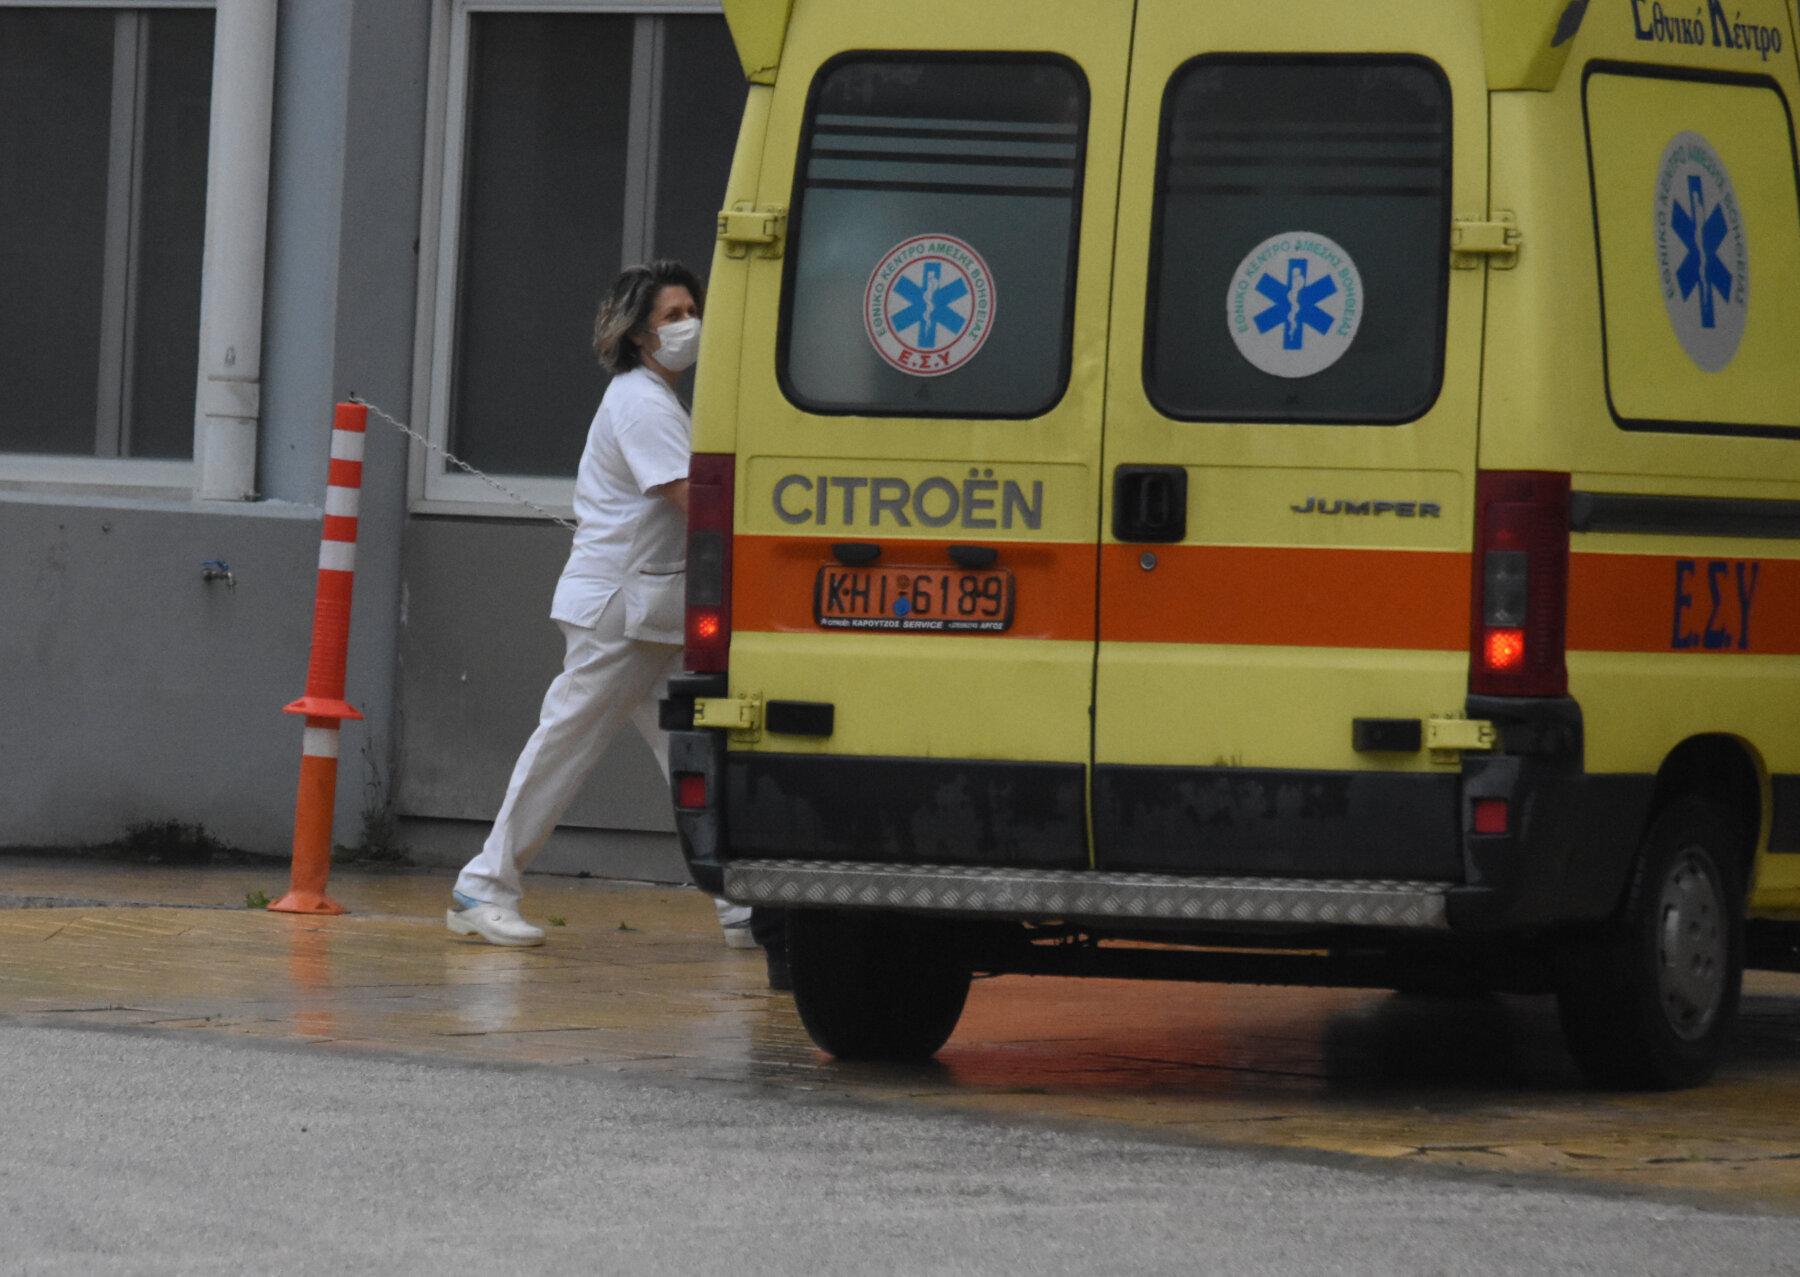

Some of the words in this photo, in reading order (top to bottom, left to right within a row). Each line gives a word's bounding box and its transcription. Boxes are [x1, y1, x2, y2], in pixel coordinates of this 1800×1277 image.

[881, 243, 925, 280] ΚΕΝΤΡΟ
[773, 468, 1043, 530] CITROËN
[1290, 496, 1441, 519] JUMPER
[903, 620, 944, 629] SERVICE
